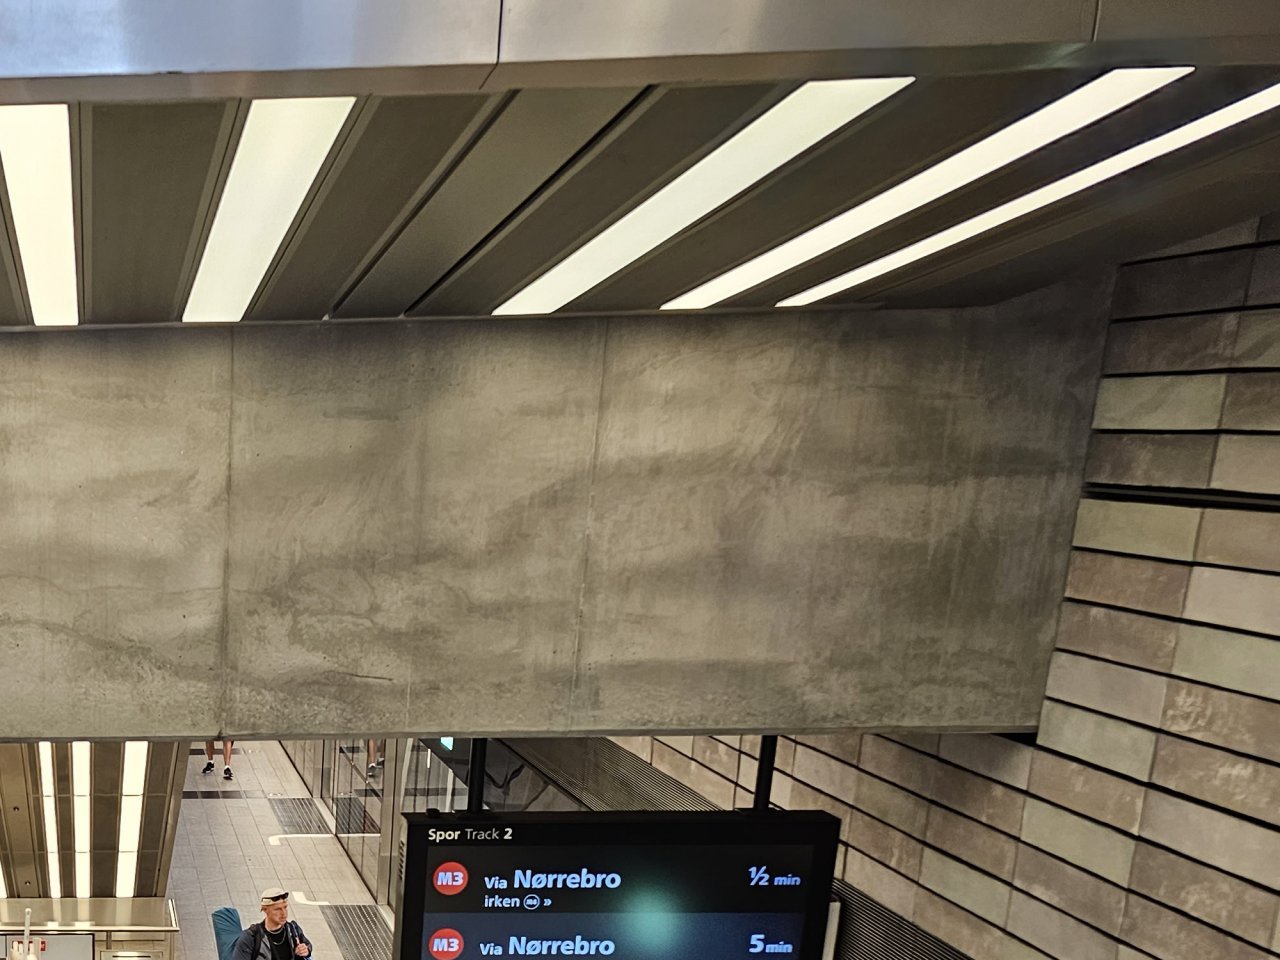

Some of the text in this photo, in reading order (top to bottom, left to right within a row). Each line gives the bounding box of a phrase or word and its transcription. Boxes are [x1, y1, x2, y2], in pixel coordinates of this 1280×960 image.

[428, 827, 513, 843] Spor Track 2
[437, 871, 465, 886] M3
[484, 867, 622, 890] Via Nørrebro
[773, 873, 801, 886] min
[483, 894, 521, 908] irken
[432, 938, 460, 952] M3
[479, 935, 616, 956] Via Nørrebro
[748, 934, 794, 953] 5 min
